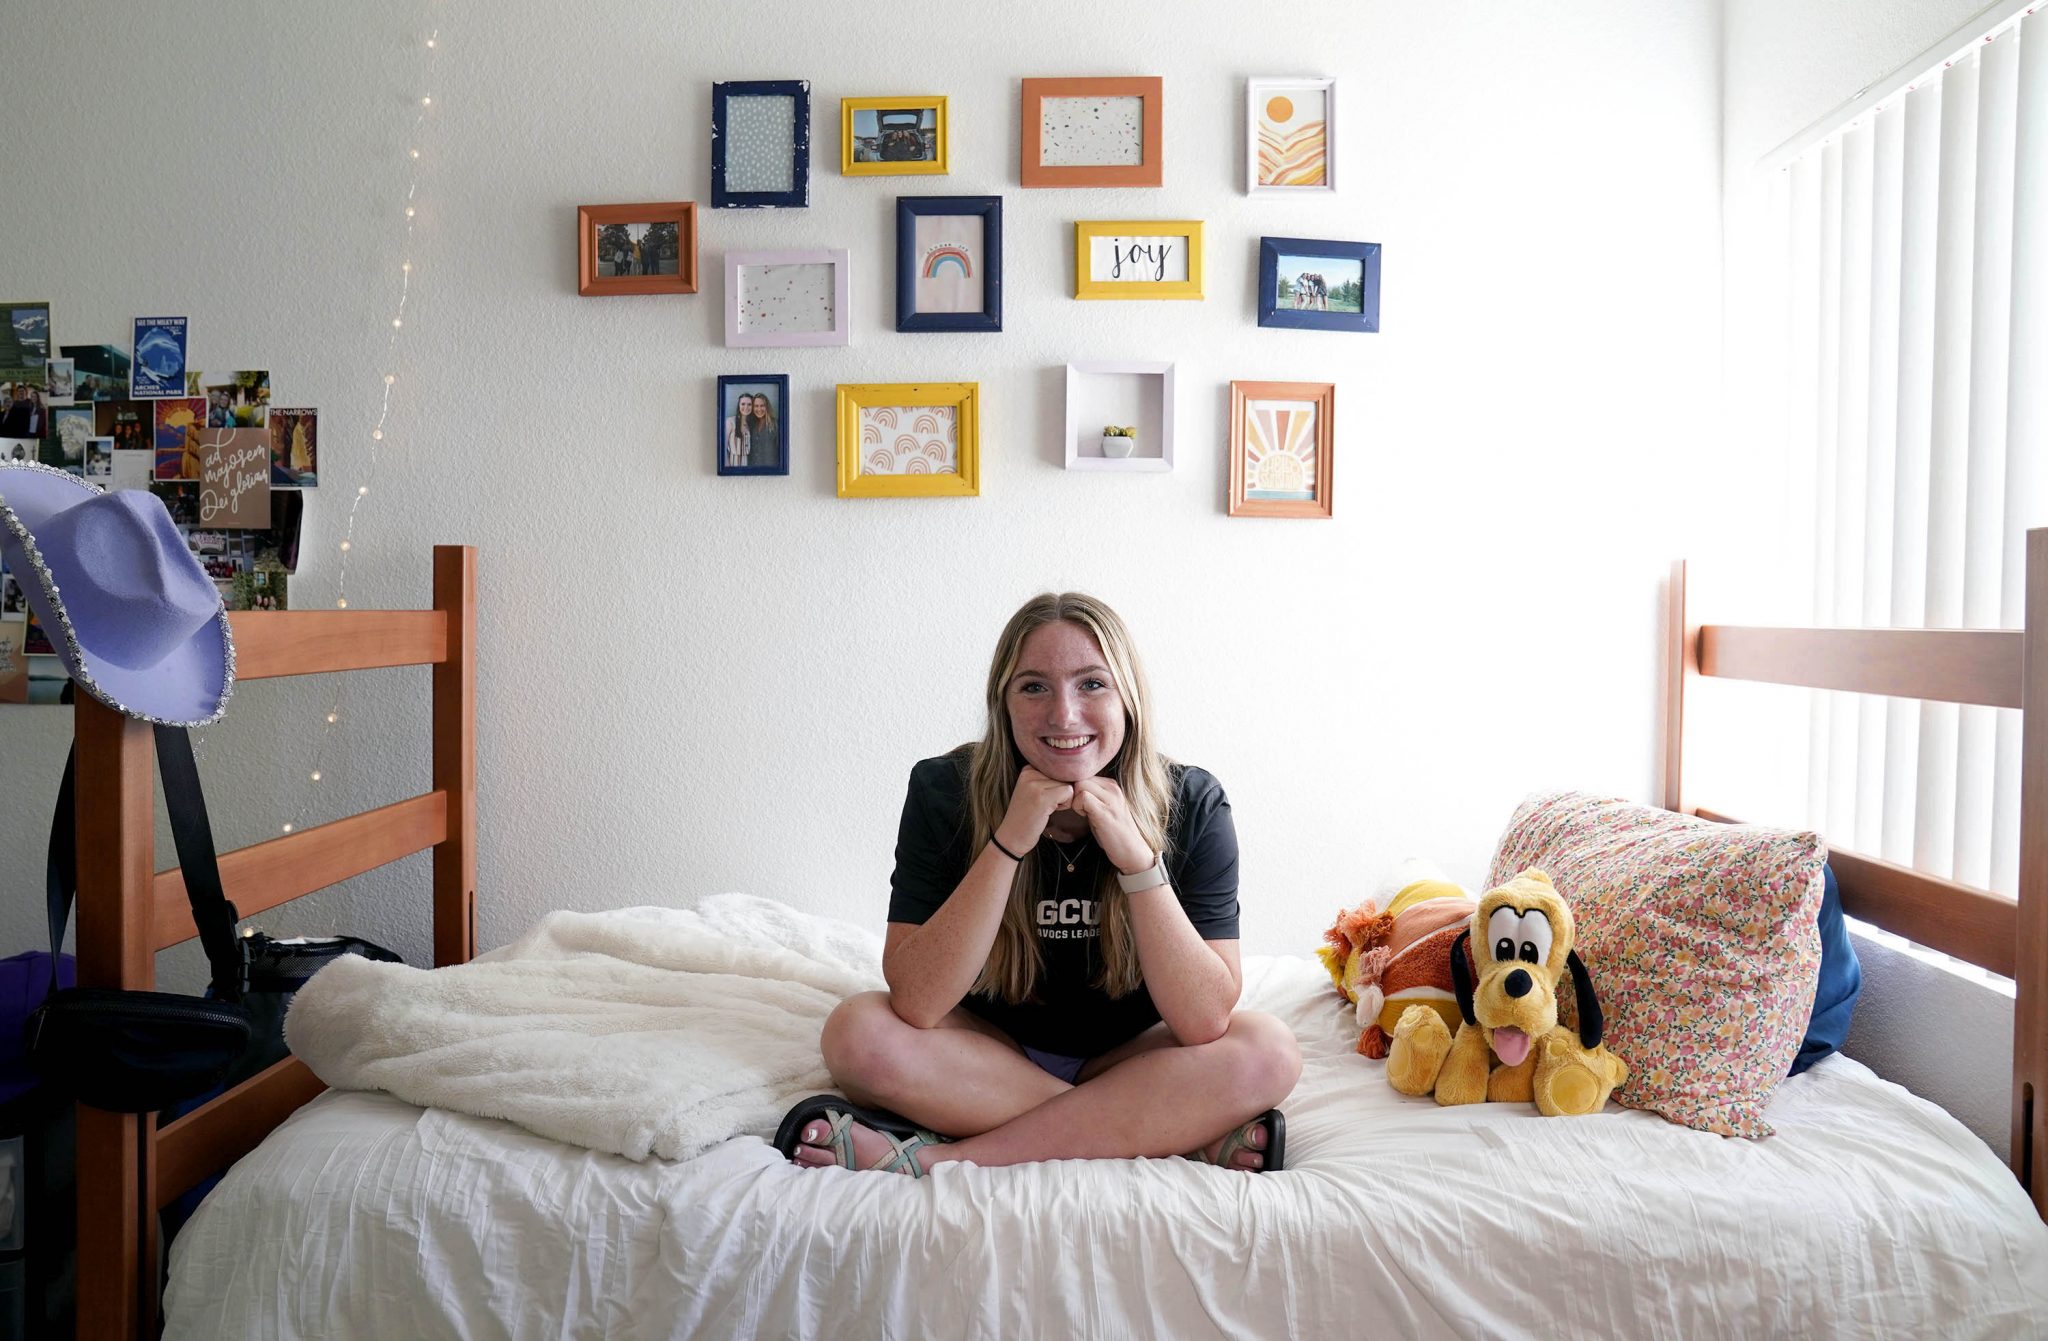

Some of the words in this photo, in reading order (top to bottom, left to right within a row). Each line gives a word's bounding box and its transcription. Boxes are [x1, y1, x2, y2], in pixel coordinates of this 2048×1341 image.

[1112, 238, 1172, 281] joy
[200, 489, 228, 521] Dei
[1036, 899, 1101, 925] GCU
[1038, 928, 1068, 938] AVOCS
[1071, 928, 1101, 938] LEADE
